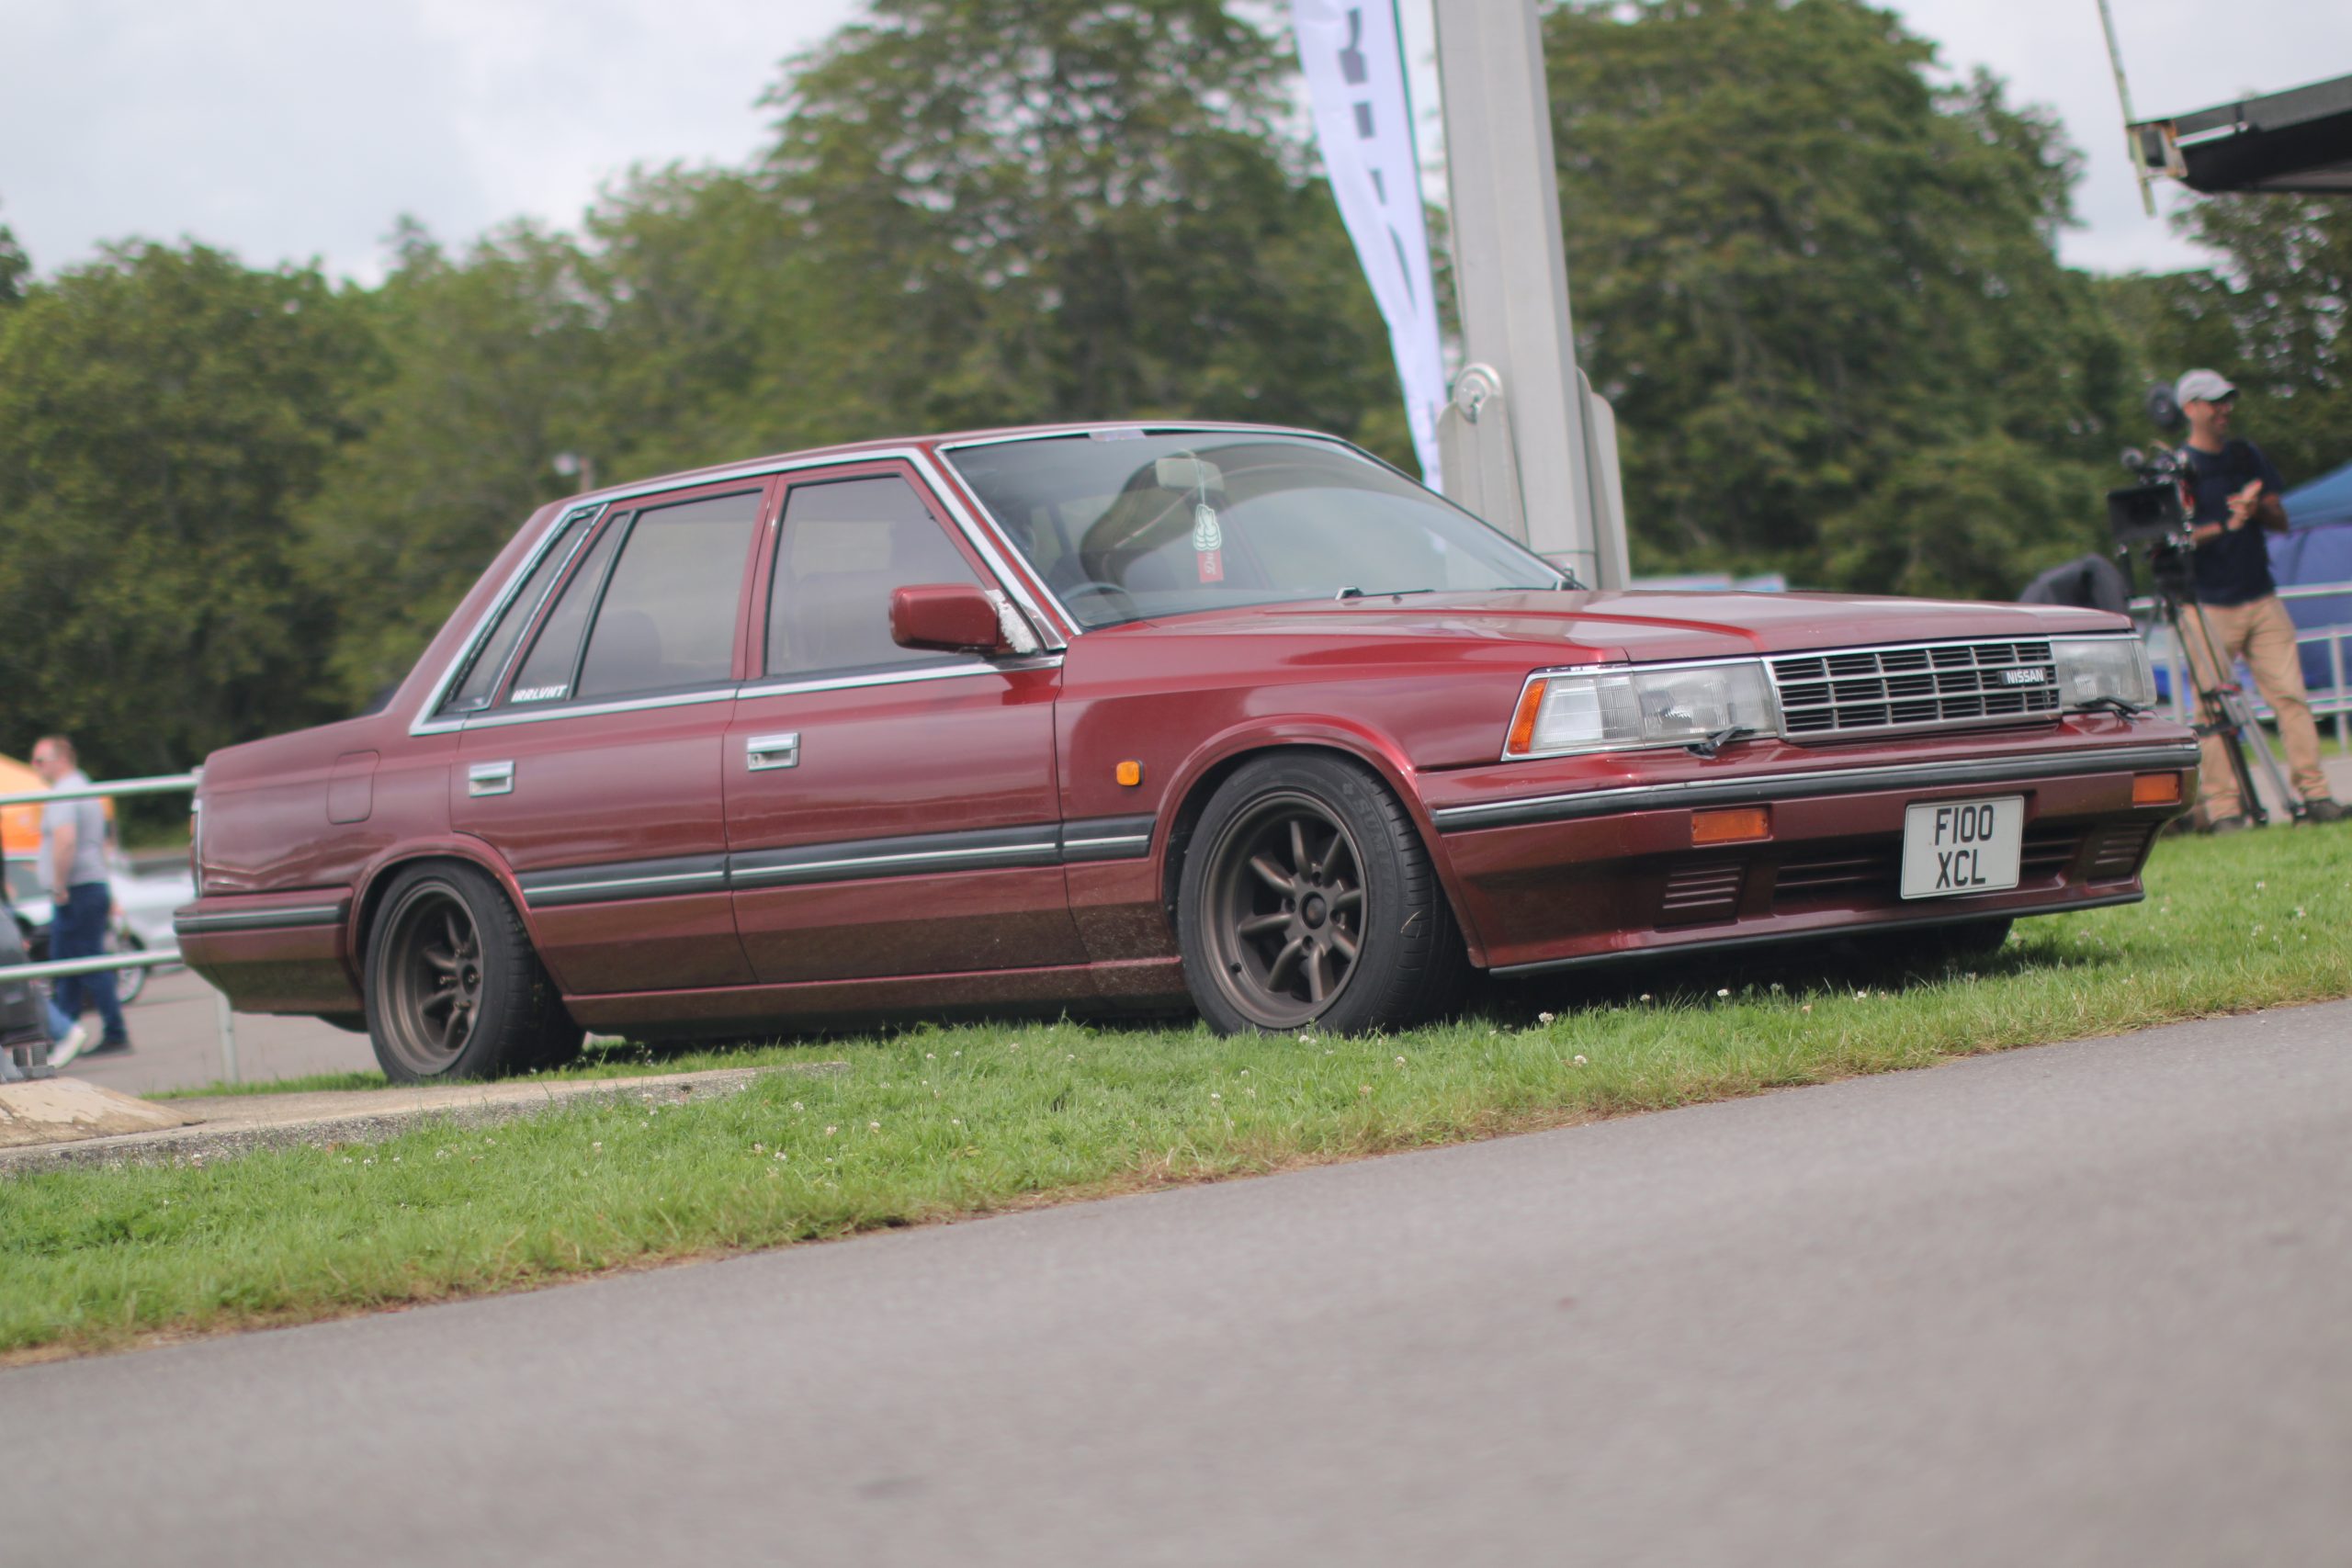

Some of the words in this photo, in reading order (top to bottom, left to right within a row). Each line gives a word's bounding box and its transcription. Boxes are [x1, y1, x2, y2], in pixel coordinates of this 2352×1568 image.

[2007, 669, 2044, 684] NISSAN
[1934, 804, 1994, 846] F100
[1935, 849, 1986, 890] XCL
